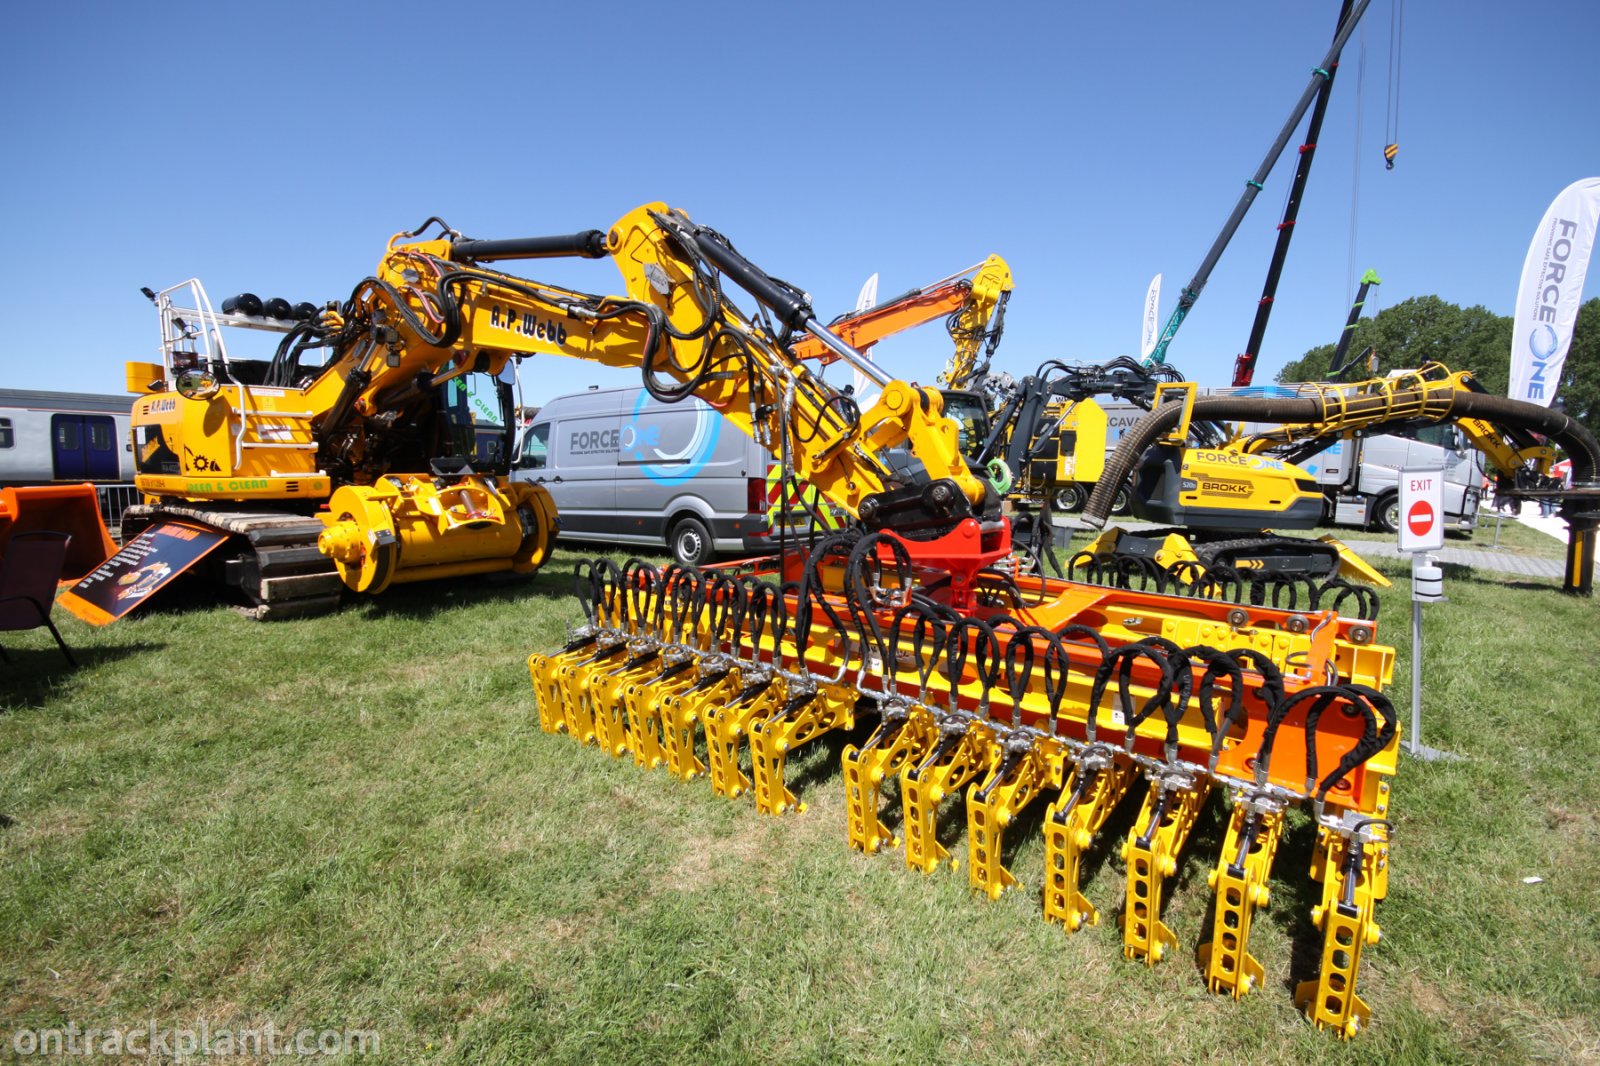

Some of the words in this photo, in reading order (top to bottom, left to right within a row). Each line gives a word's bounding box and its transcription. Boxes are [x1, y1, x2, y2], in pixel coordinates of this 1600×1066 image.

[1538, 218, 1578, 324] FORCE
[570, 429, 620, 450] FORCE
[1473, 419, 1502, 449] BROKK
[1322, 443, 1343, 455] NE
[1196, 452, 1247, 466] FORCE
[228, 479, 268, 491] CLEAN
[1202, 482, 1247, 493] BROKK
[1410, 479, 1432, 491] EXIT
